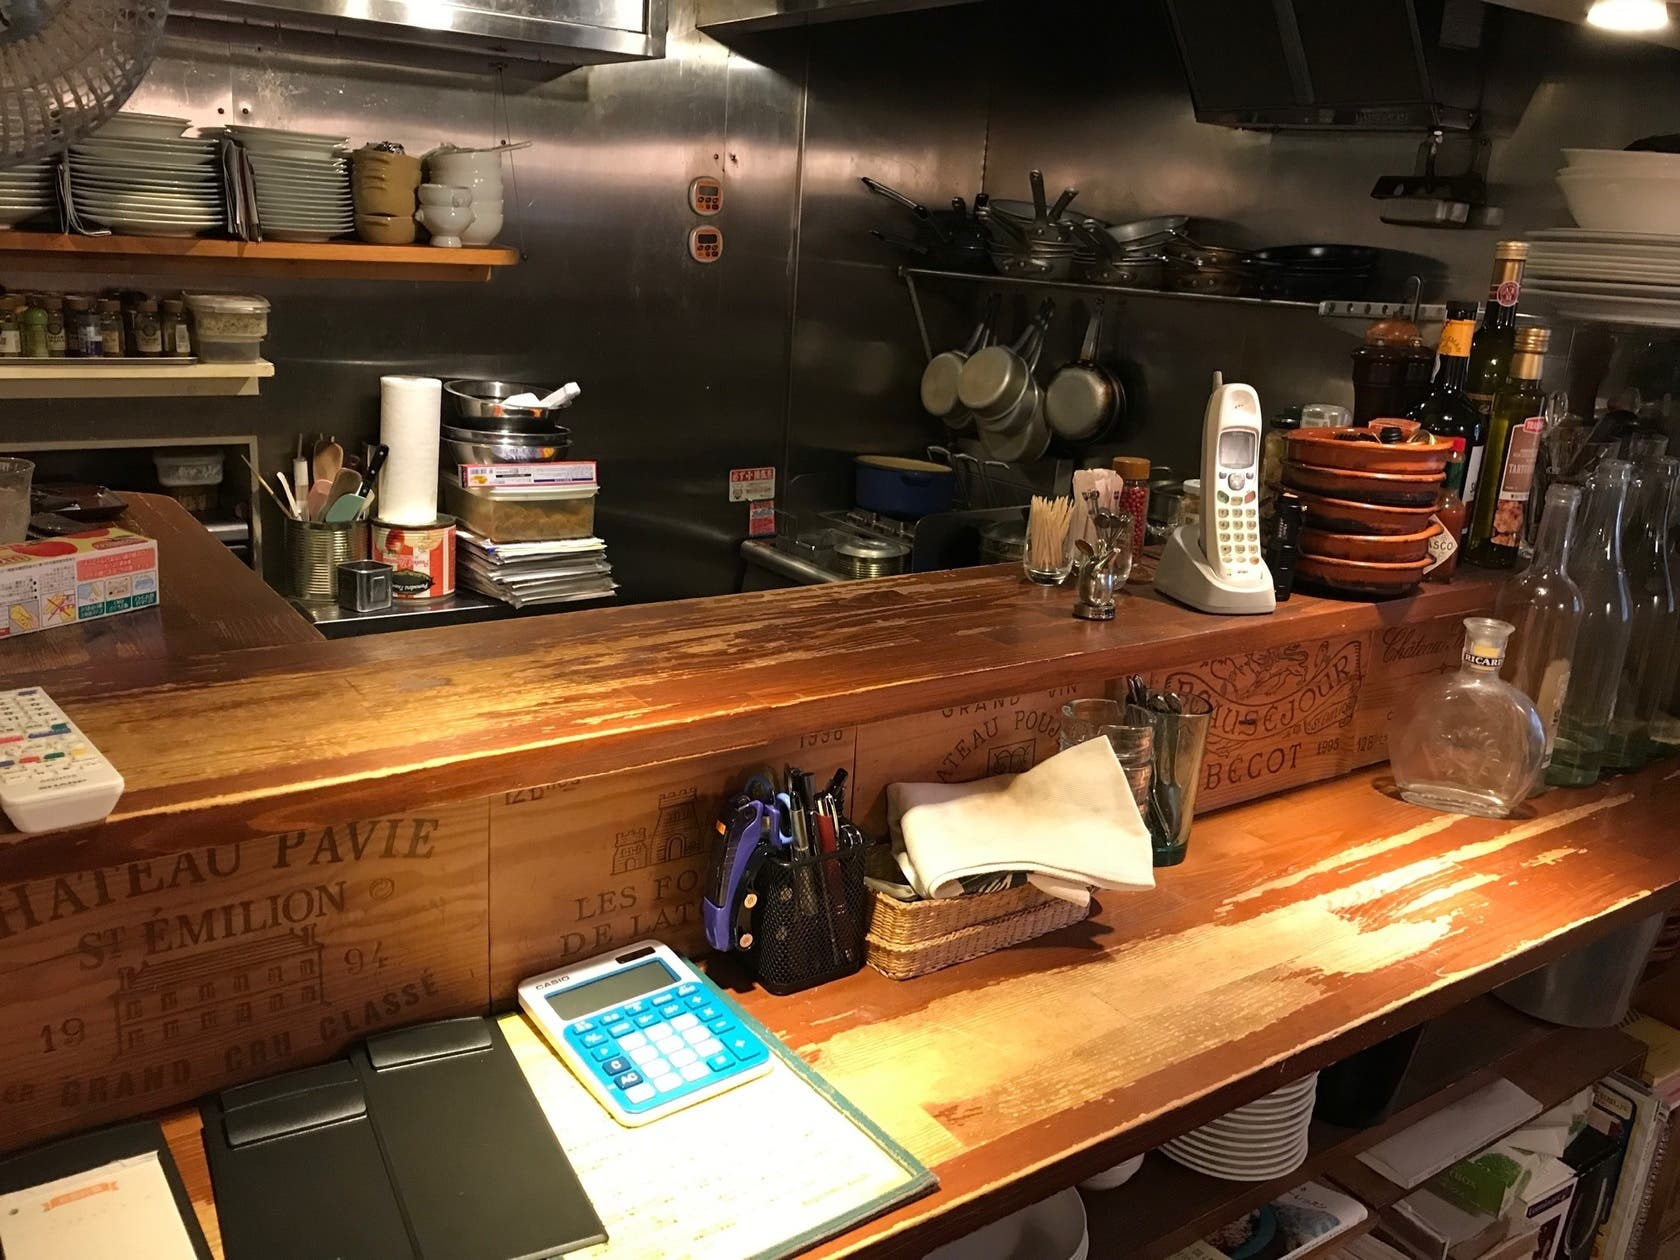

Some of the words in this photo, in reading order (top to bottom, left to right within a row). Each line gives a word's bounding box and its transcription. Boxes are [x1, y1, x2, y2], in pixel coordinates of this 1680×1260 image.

[1014, 710, 1062, 742] POUJ
[273, 817, 440, 869] PAVIE
[145, 881, 346, 955] ÉMILION
[574, 885, 638, 921] LES
[628, 903, 694, 939] LAT
[39, 1016, 87, 1054] 19
[343, 939, 390, 976] 94
[535, 975, 570, 991] CASIO
[59, 1057, 192, 1107] GRAND
